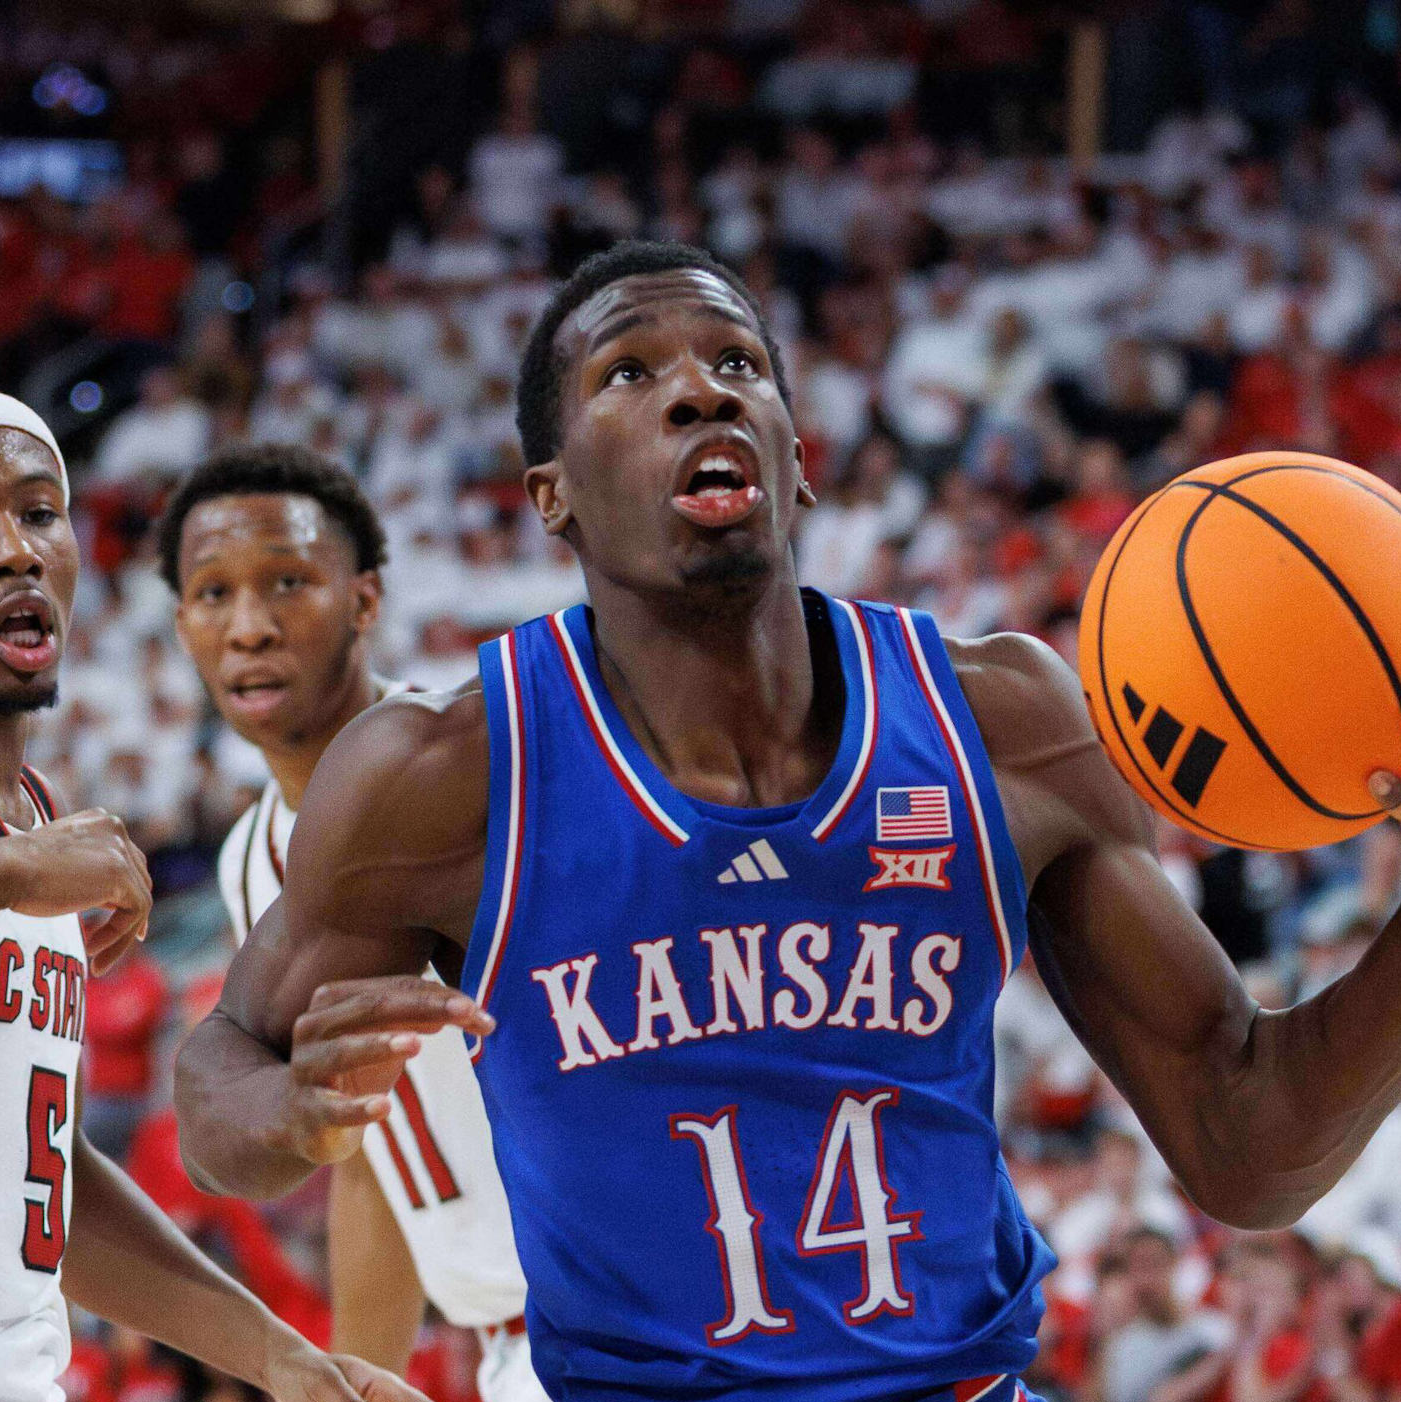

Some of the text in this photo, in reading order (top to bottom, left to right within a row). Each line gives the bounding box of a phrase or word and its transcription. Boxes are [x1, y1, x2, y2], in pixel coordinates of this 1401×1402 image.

[29, 945, 85, 1045] STAT
[532, 921, 963, 1073] KANSAS
[20, 1064, 68, 1274] 5
[669, 1087, 924, 1347] 14
